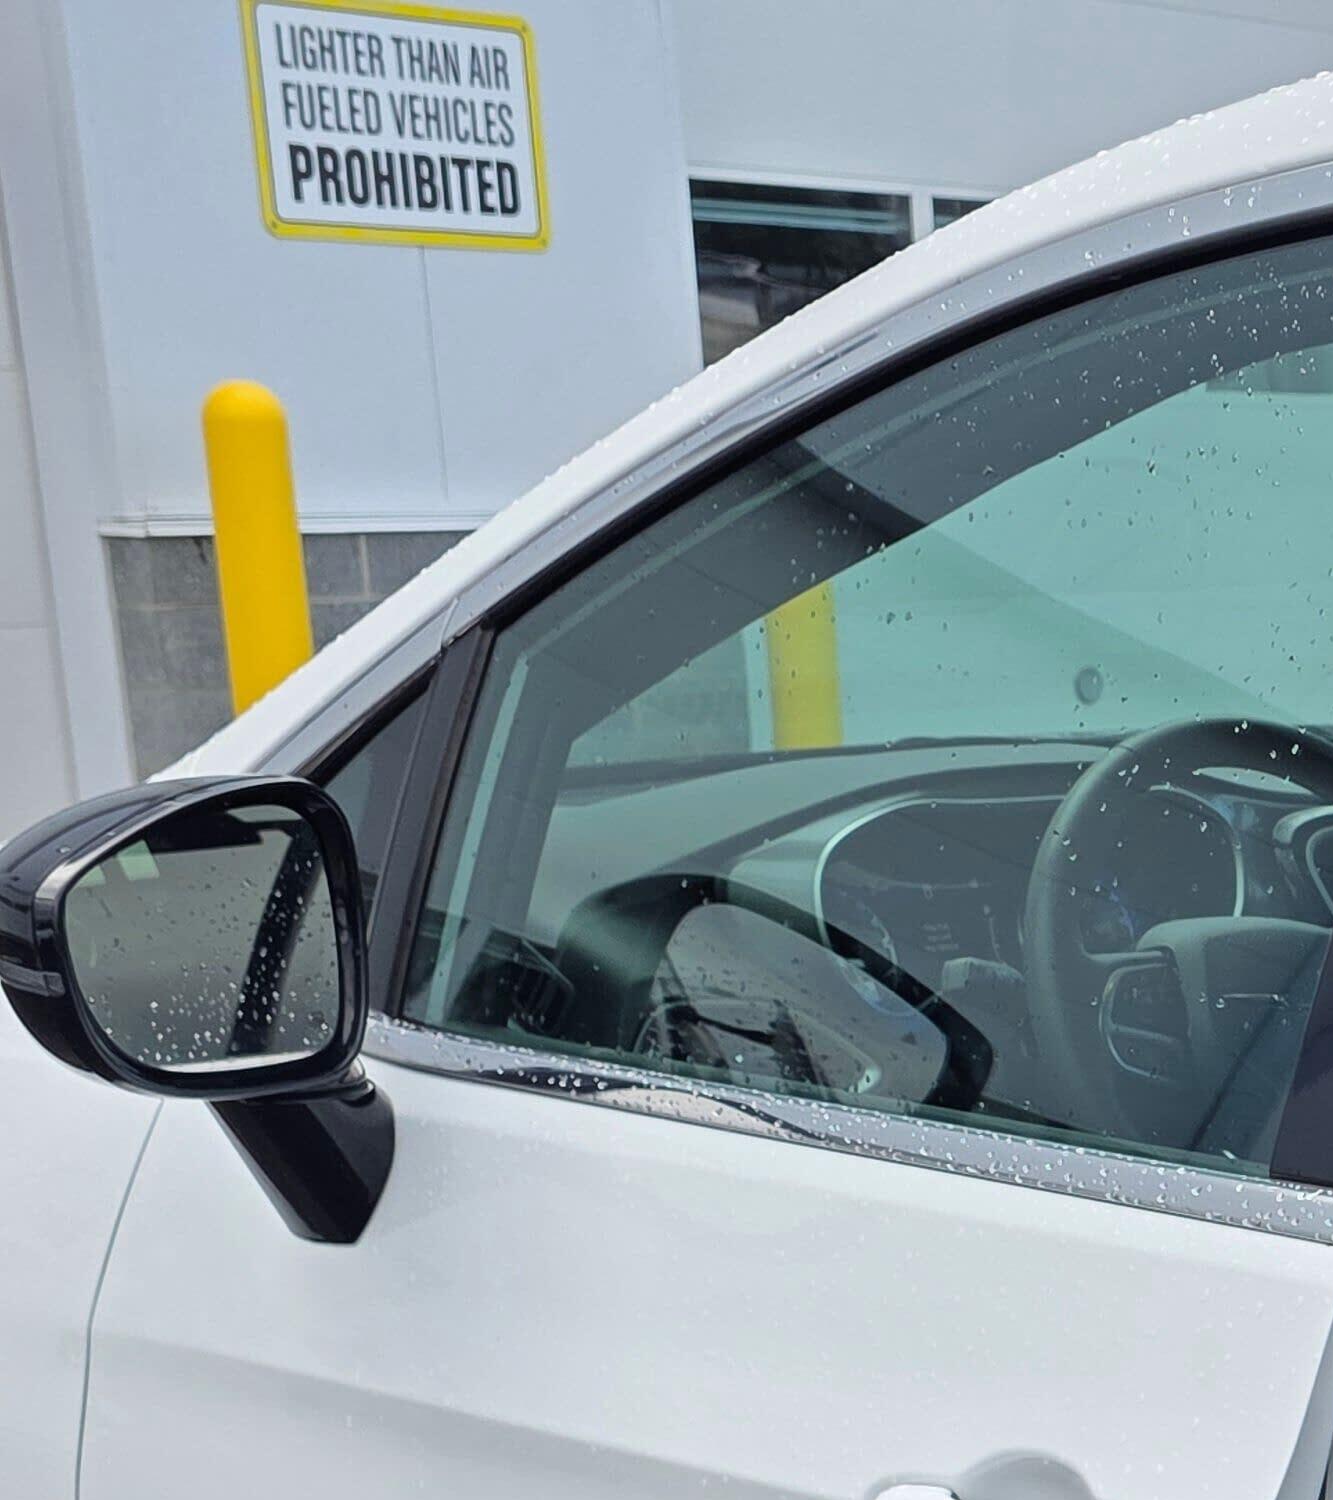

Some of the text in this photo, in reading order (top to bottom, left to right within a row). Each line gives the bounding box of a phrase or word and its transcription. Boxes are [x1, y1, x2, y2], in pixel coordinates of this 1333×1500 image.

[274, 23, 510, 91] LIGHTER THAN AIR
[281, 81, 515, 148] FUELED VEHICLES
[288, 143, 520, 216] PROHIBITED
